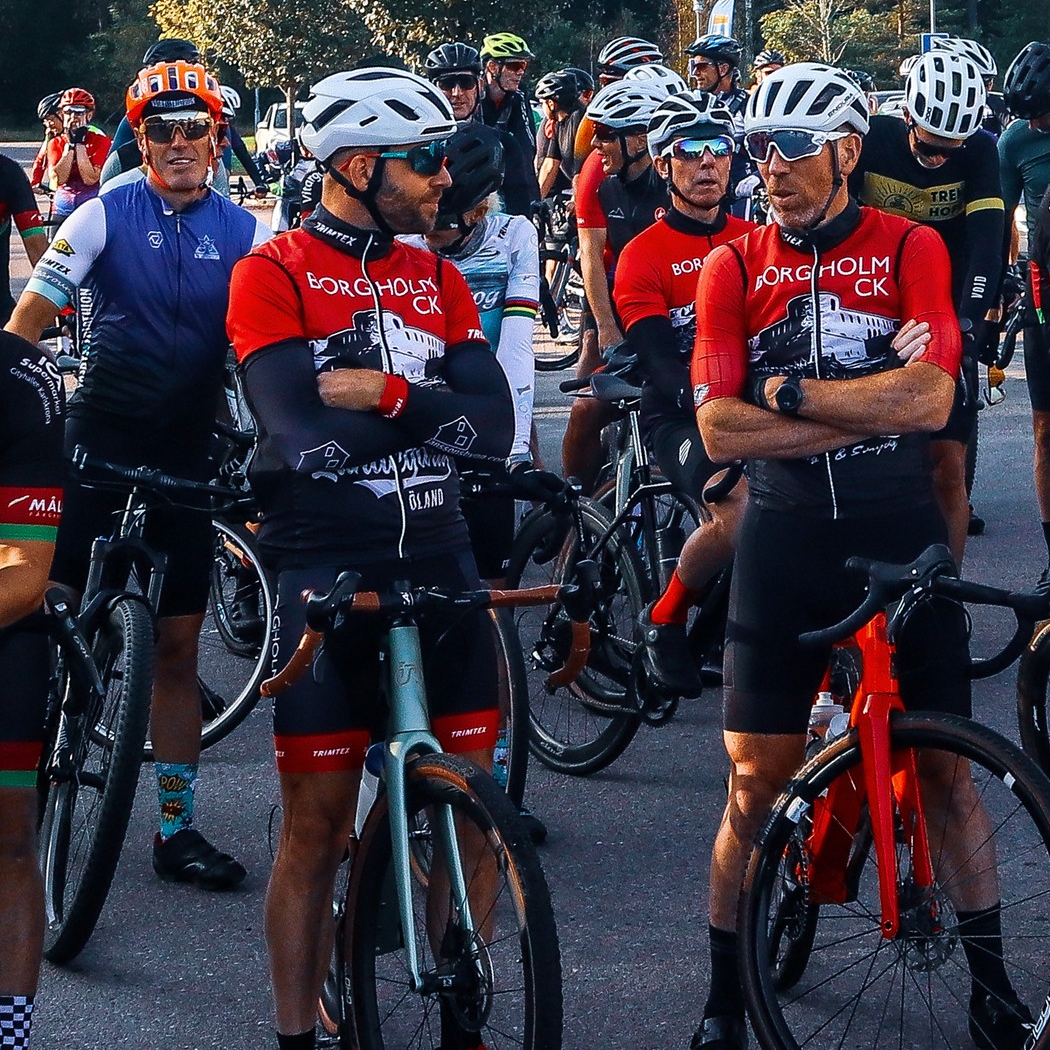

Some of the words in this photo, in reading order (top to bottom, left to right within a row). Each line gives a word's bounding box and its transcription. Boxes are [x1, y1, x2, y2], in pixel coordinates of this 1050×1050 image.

[306, 271, 438, 298] BORGHOLM
[854, 276, 889, 297] CK
[970, 275, 988, 300] VOID
[412, 295, 443, 315] CK
[29, 495, 63, 513] MÅL
[408, 488, 434, 511] ÖLAND
[450, 726, 488, 738] TRIMTEX
[312, 747, 350, 757] TRIMTEX
